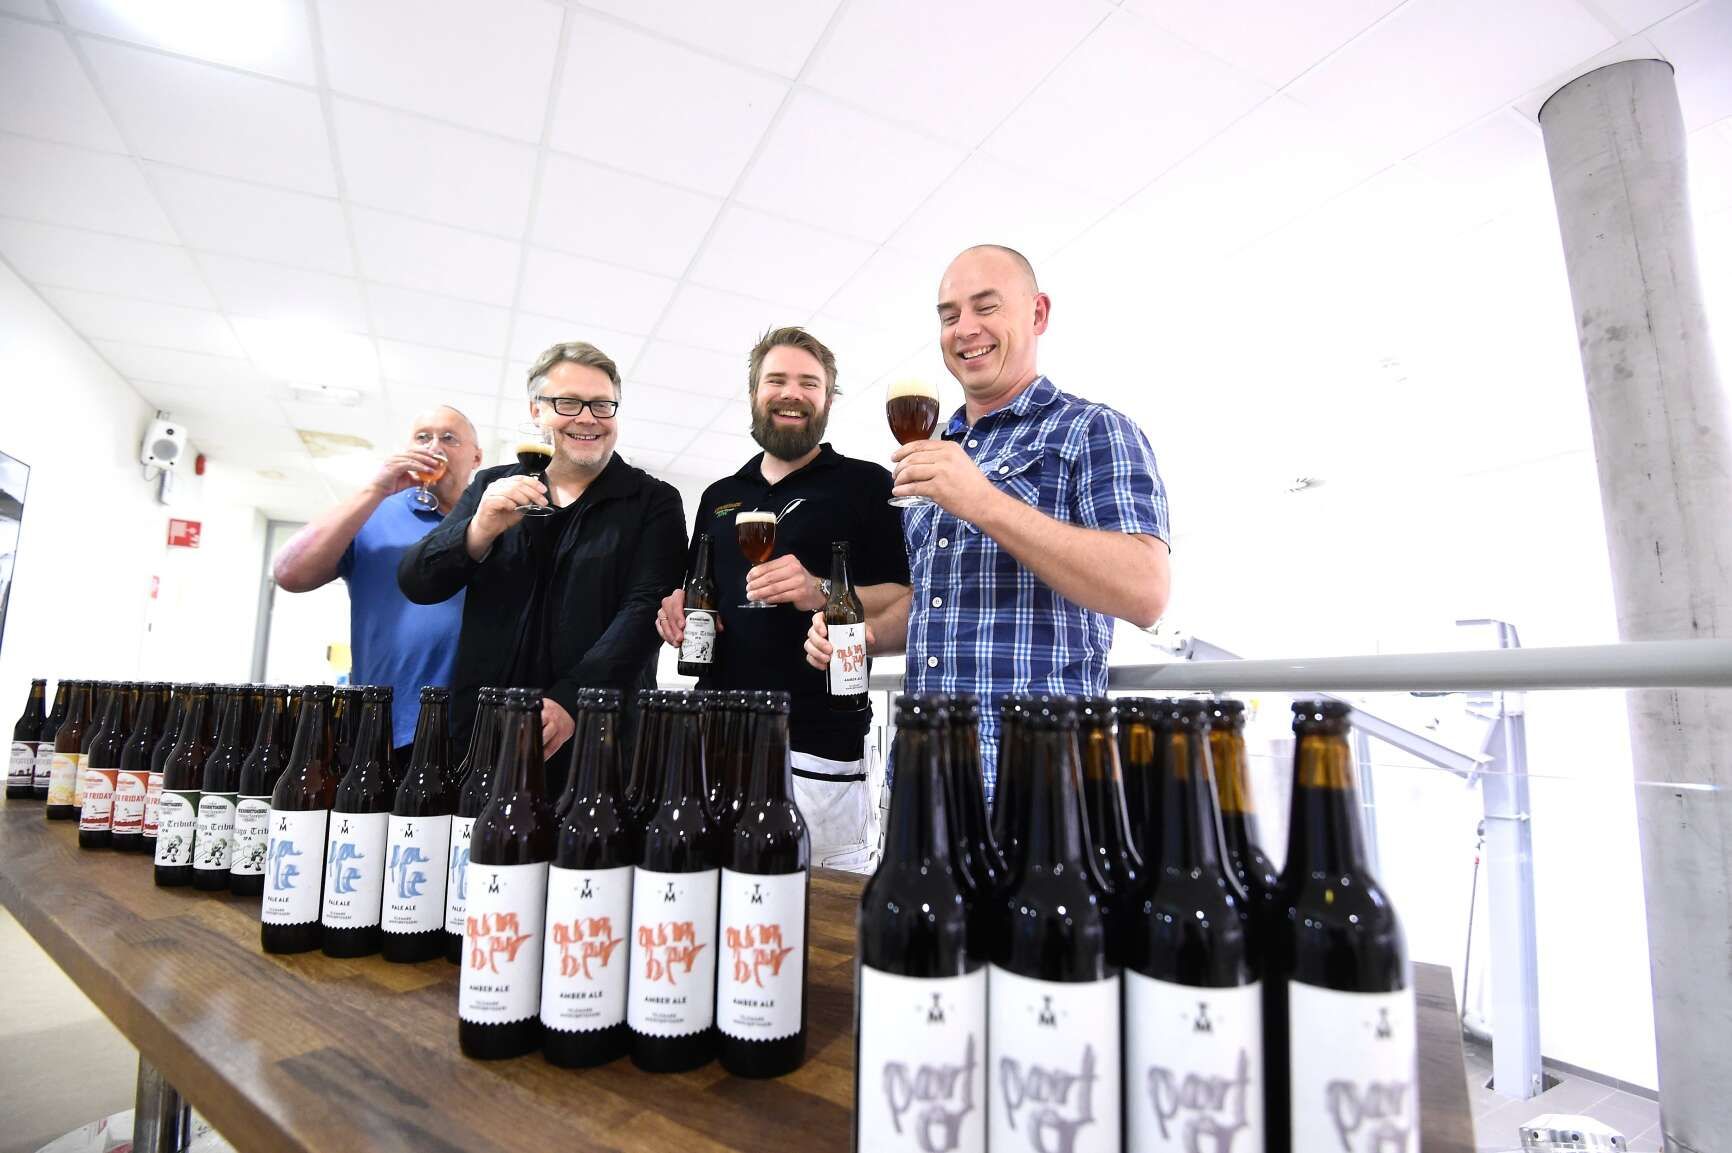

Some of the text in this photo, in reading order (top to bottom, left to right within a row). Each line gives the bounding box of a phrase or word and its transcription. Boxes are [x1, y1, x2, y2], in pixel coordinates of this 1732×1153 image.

[89, 792, 113, 800] FRIDAY
[121, 794, 144, 802] FRIDAY
[211, 823, 234, 831] Tribu
[469, 985, 510, 993] AMBER ALE
[589, 991, 603, 999] ALE
[645, 996, 686, 1004] AMBER ALE
[733, 998, 758, 1007] AMBER
